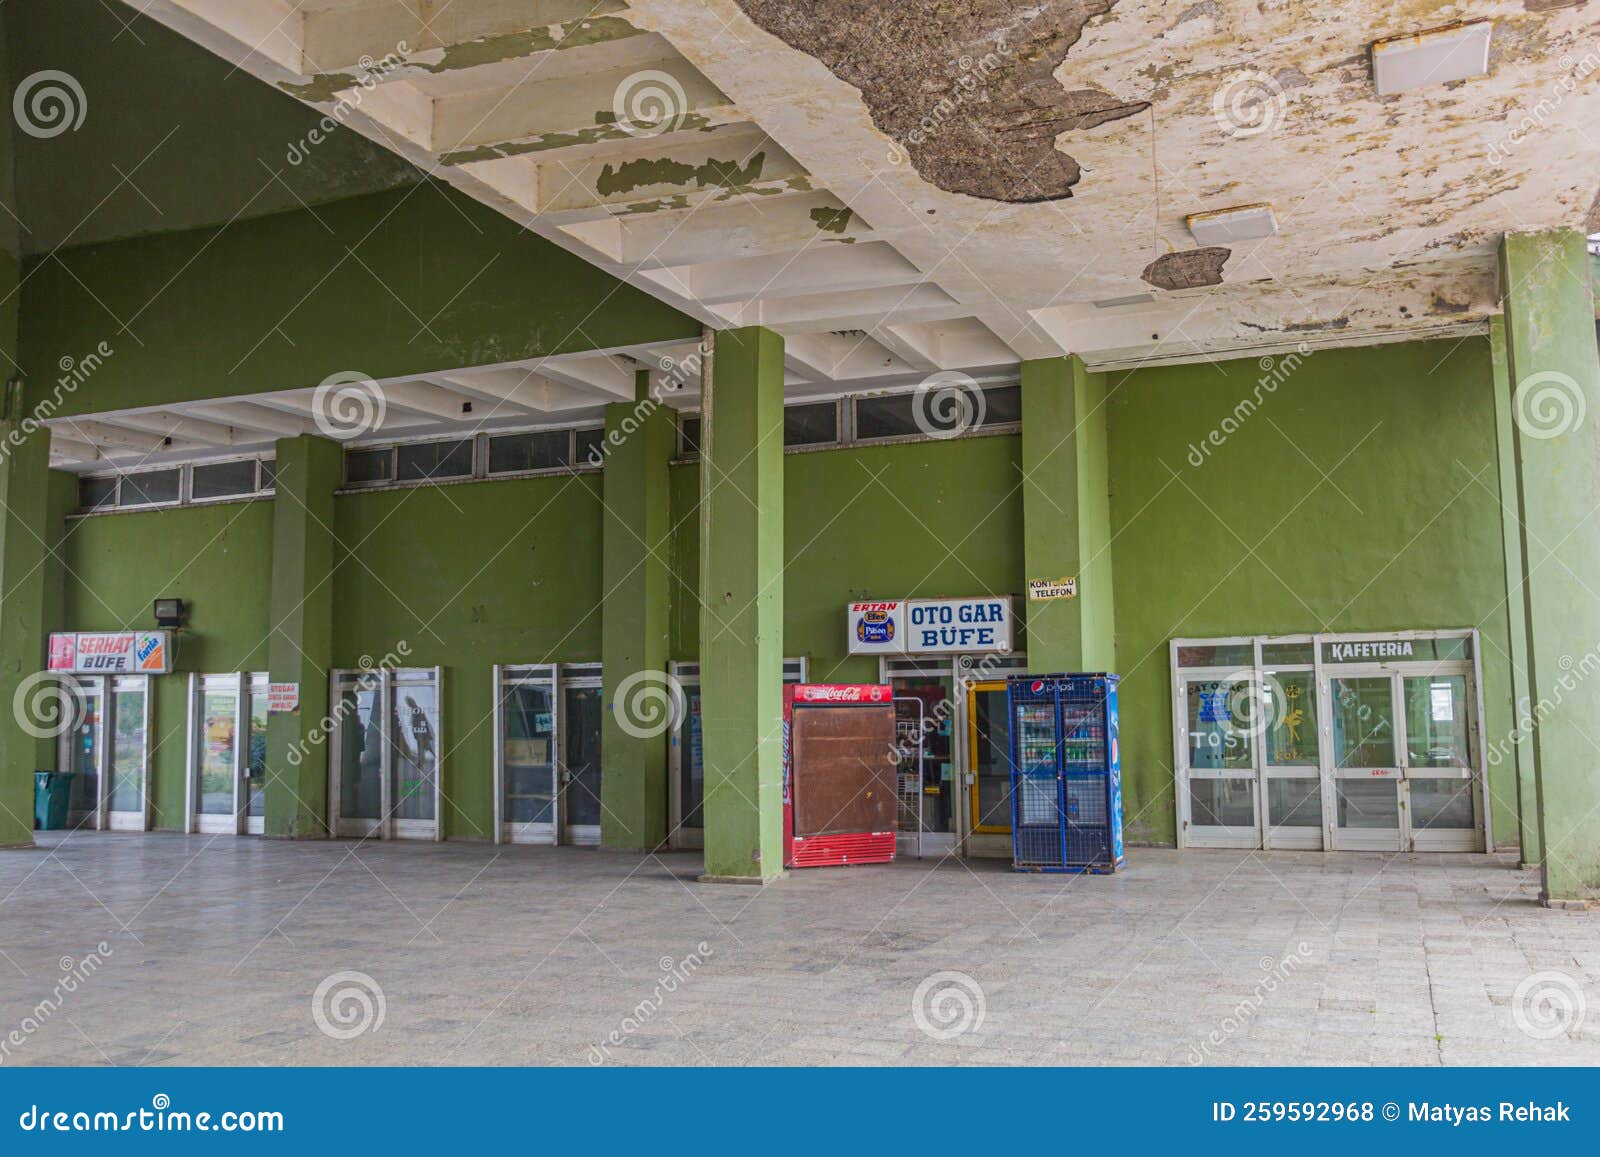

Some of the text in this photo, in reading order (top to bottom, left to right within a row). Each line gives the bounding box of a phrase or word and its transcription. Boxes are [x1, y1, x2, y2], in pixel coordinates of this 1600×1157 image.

[1035, 588, 1072, 598] TELEFON
[853, 603, 897, 611] ERTAN
[911, 603, 1003, 625] OTO GAR
[79, 636, 133, 654] SERHAT
[921, 626, 994, 647] BÜFE
[1189, 730, 1251, 749] TOST
